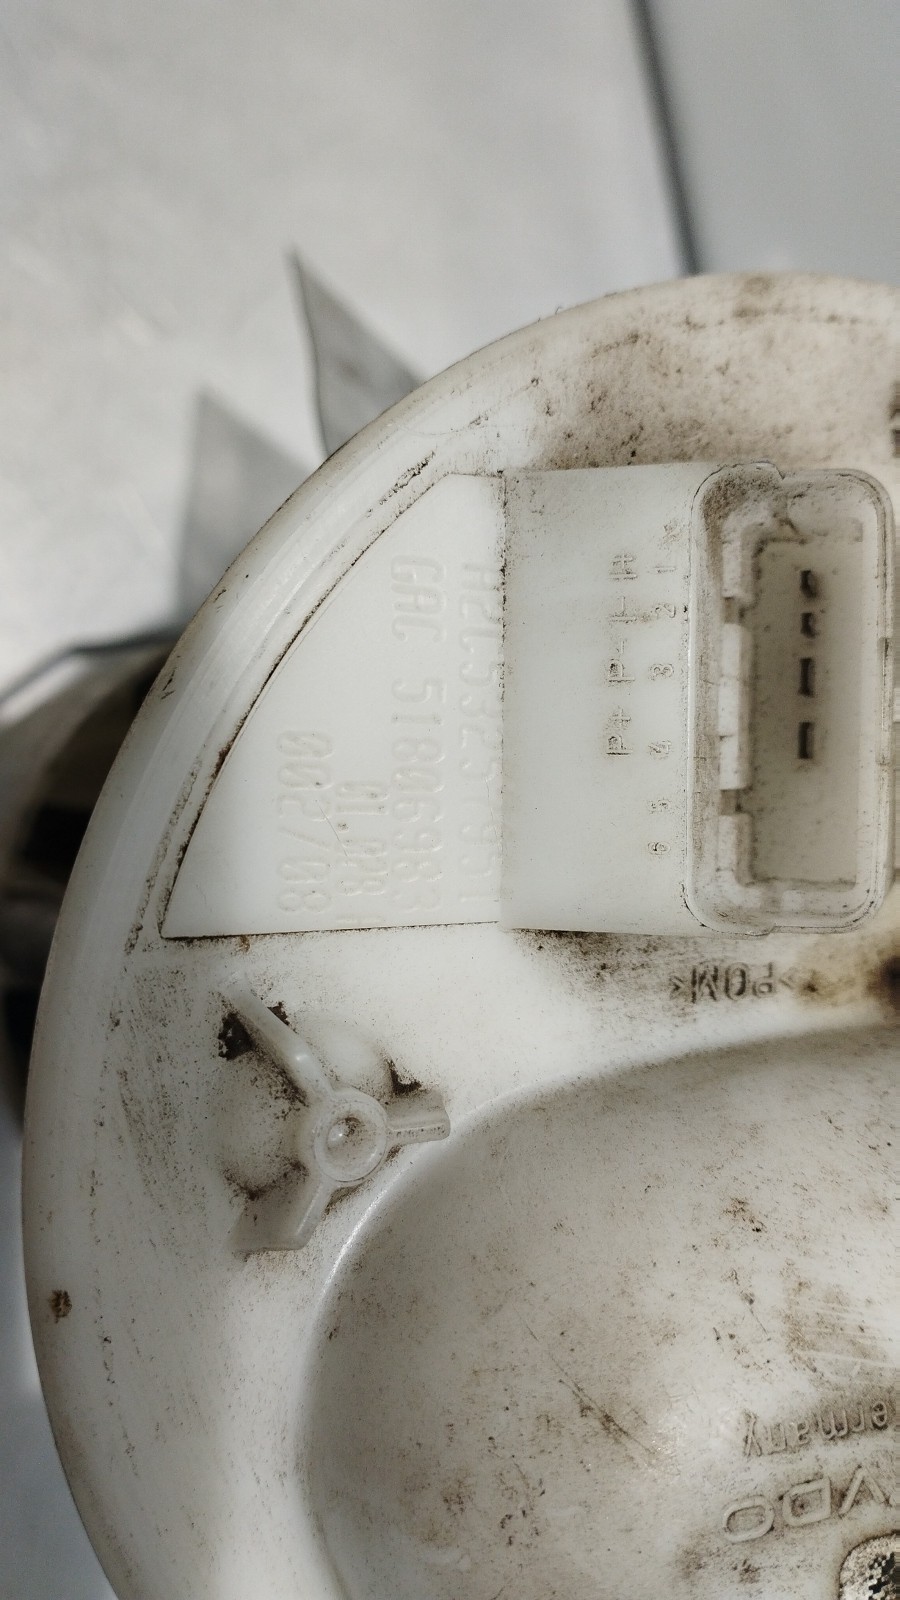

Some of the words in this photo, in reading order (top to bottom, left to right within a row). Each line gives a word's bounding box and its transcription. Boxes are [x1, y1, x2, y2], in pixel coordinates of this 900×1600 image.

[390, 554, 447, 644] GAC
[390, 675, 447, 914] 51806983
[742, 1400, 890, 1458] ermany
[722, 1465, 898, 1544] VDO
